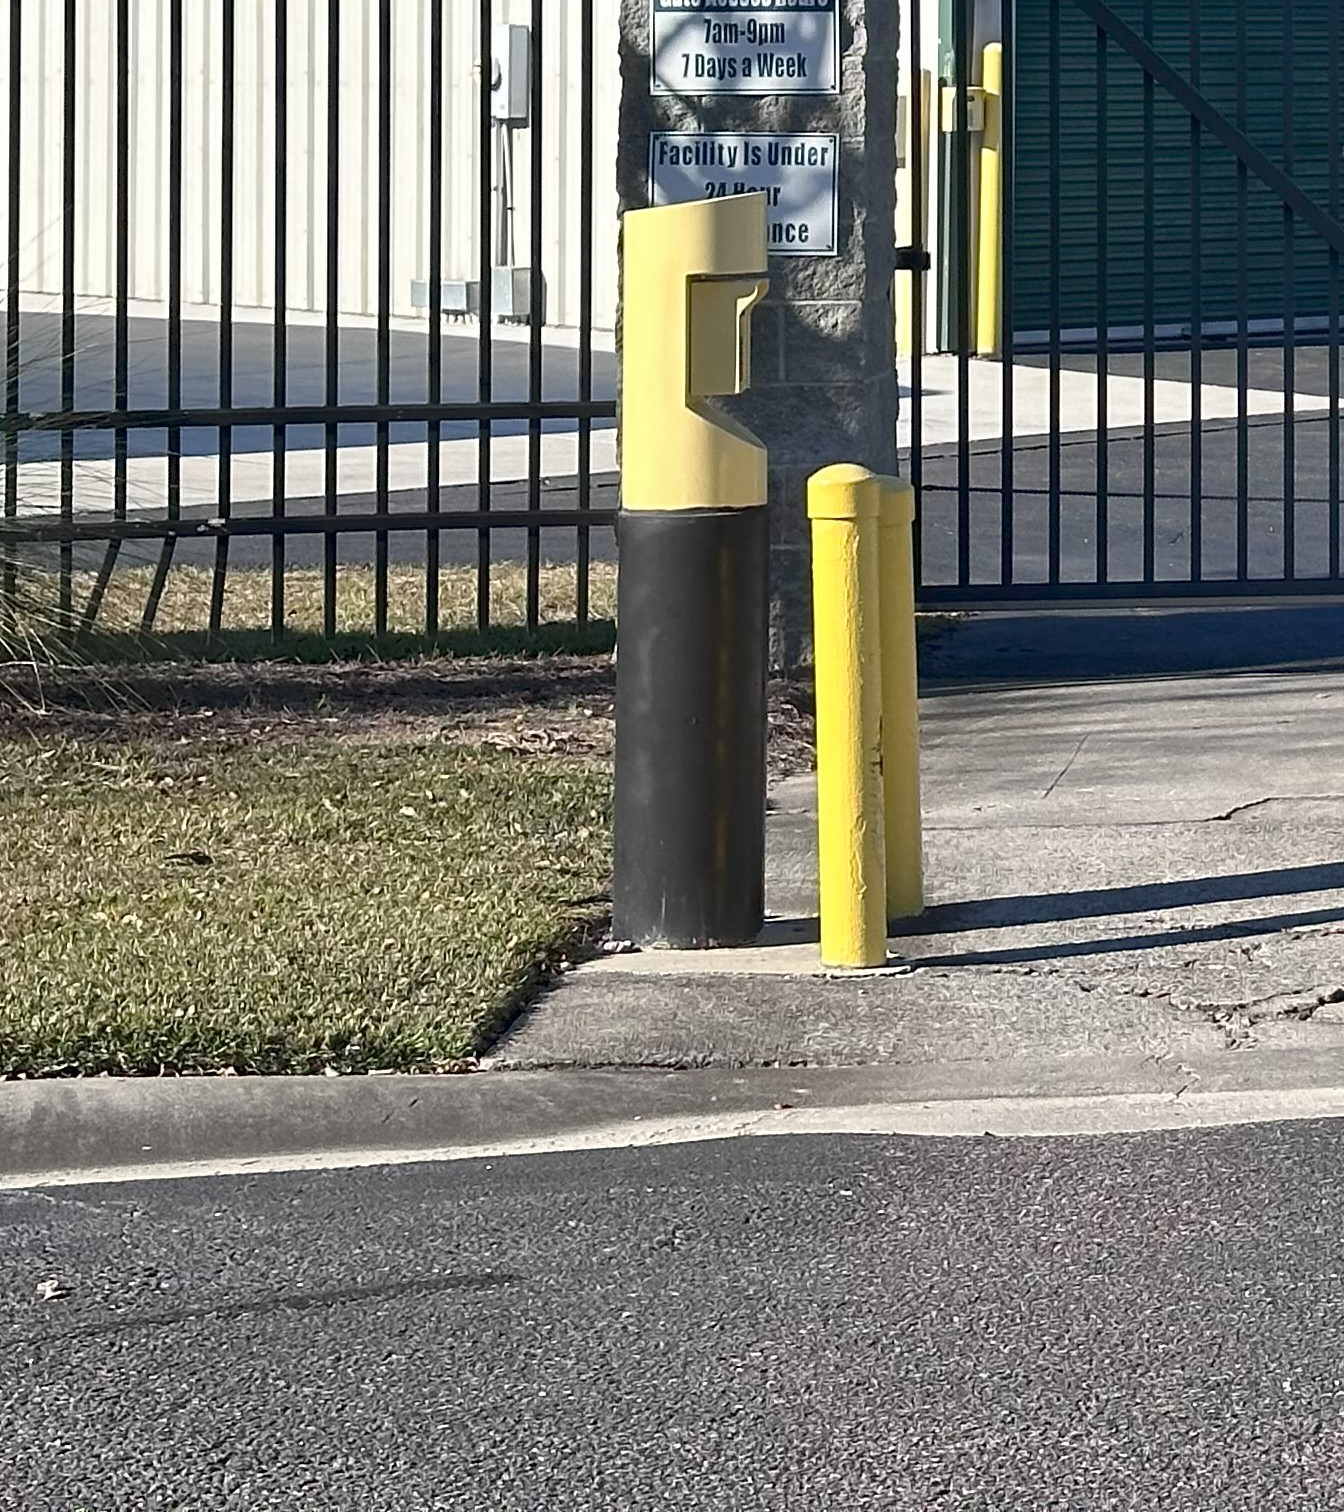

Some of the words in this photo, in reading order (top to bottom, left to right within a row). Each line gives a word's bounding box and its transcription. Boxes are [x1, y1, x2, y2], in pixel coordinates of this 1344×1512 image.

[703, 18, 785, 46] 7am-9pm
[681, 53, 690, 78] 7
[695, 53, 737, 81] Days
[742, 58, 752, 77] a
[756, 52, 807, 78] Week
[658, 140, 738, 168] Facility
[743, 141, 762, 166] Is
[767, 141, 828, 166] Under
[705, 182, 727, 199] 24
[733, 181, 781, 206] Hur
